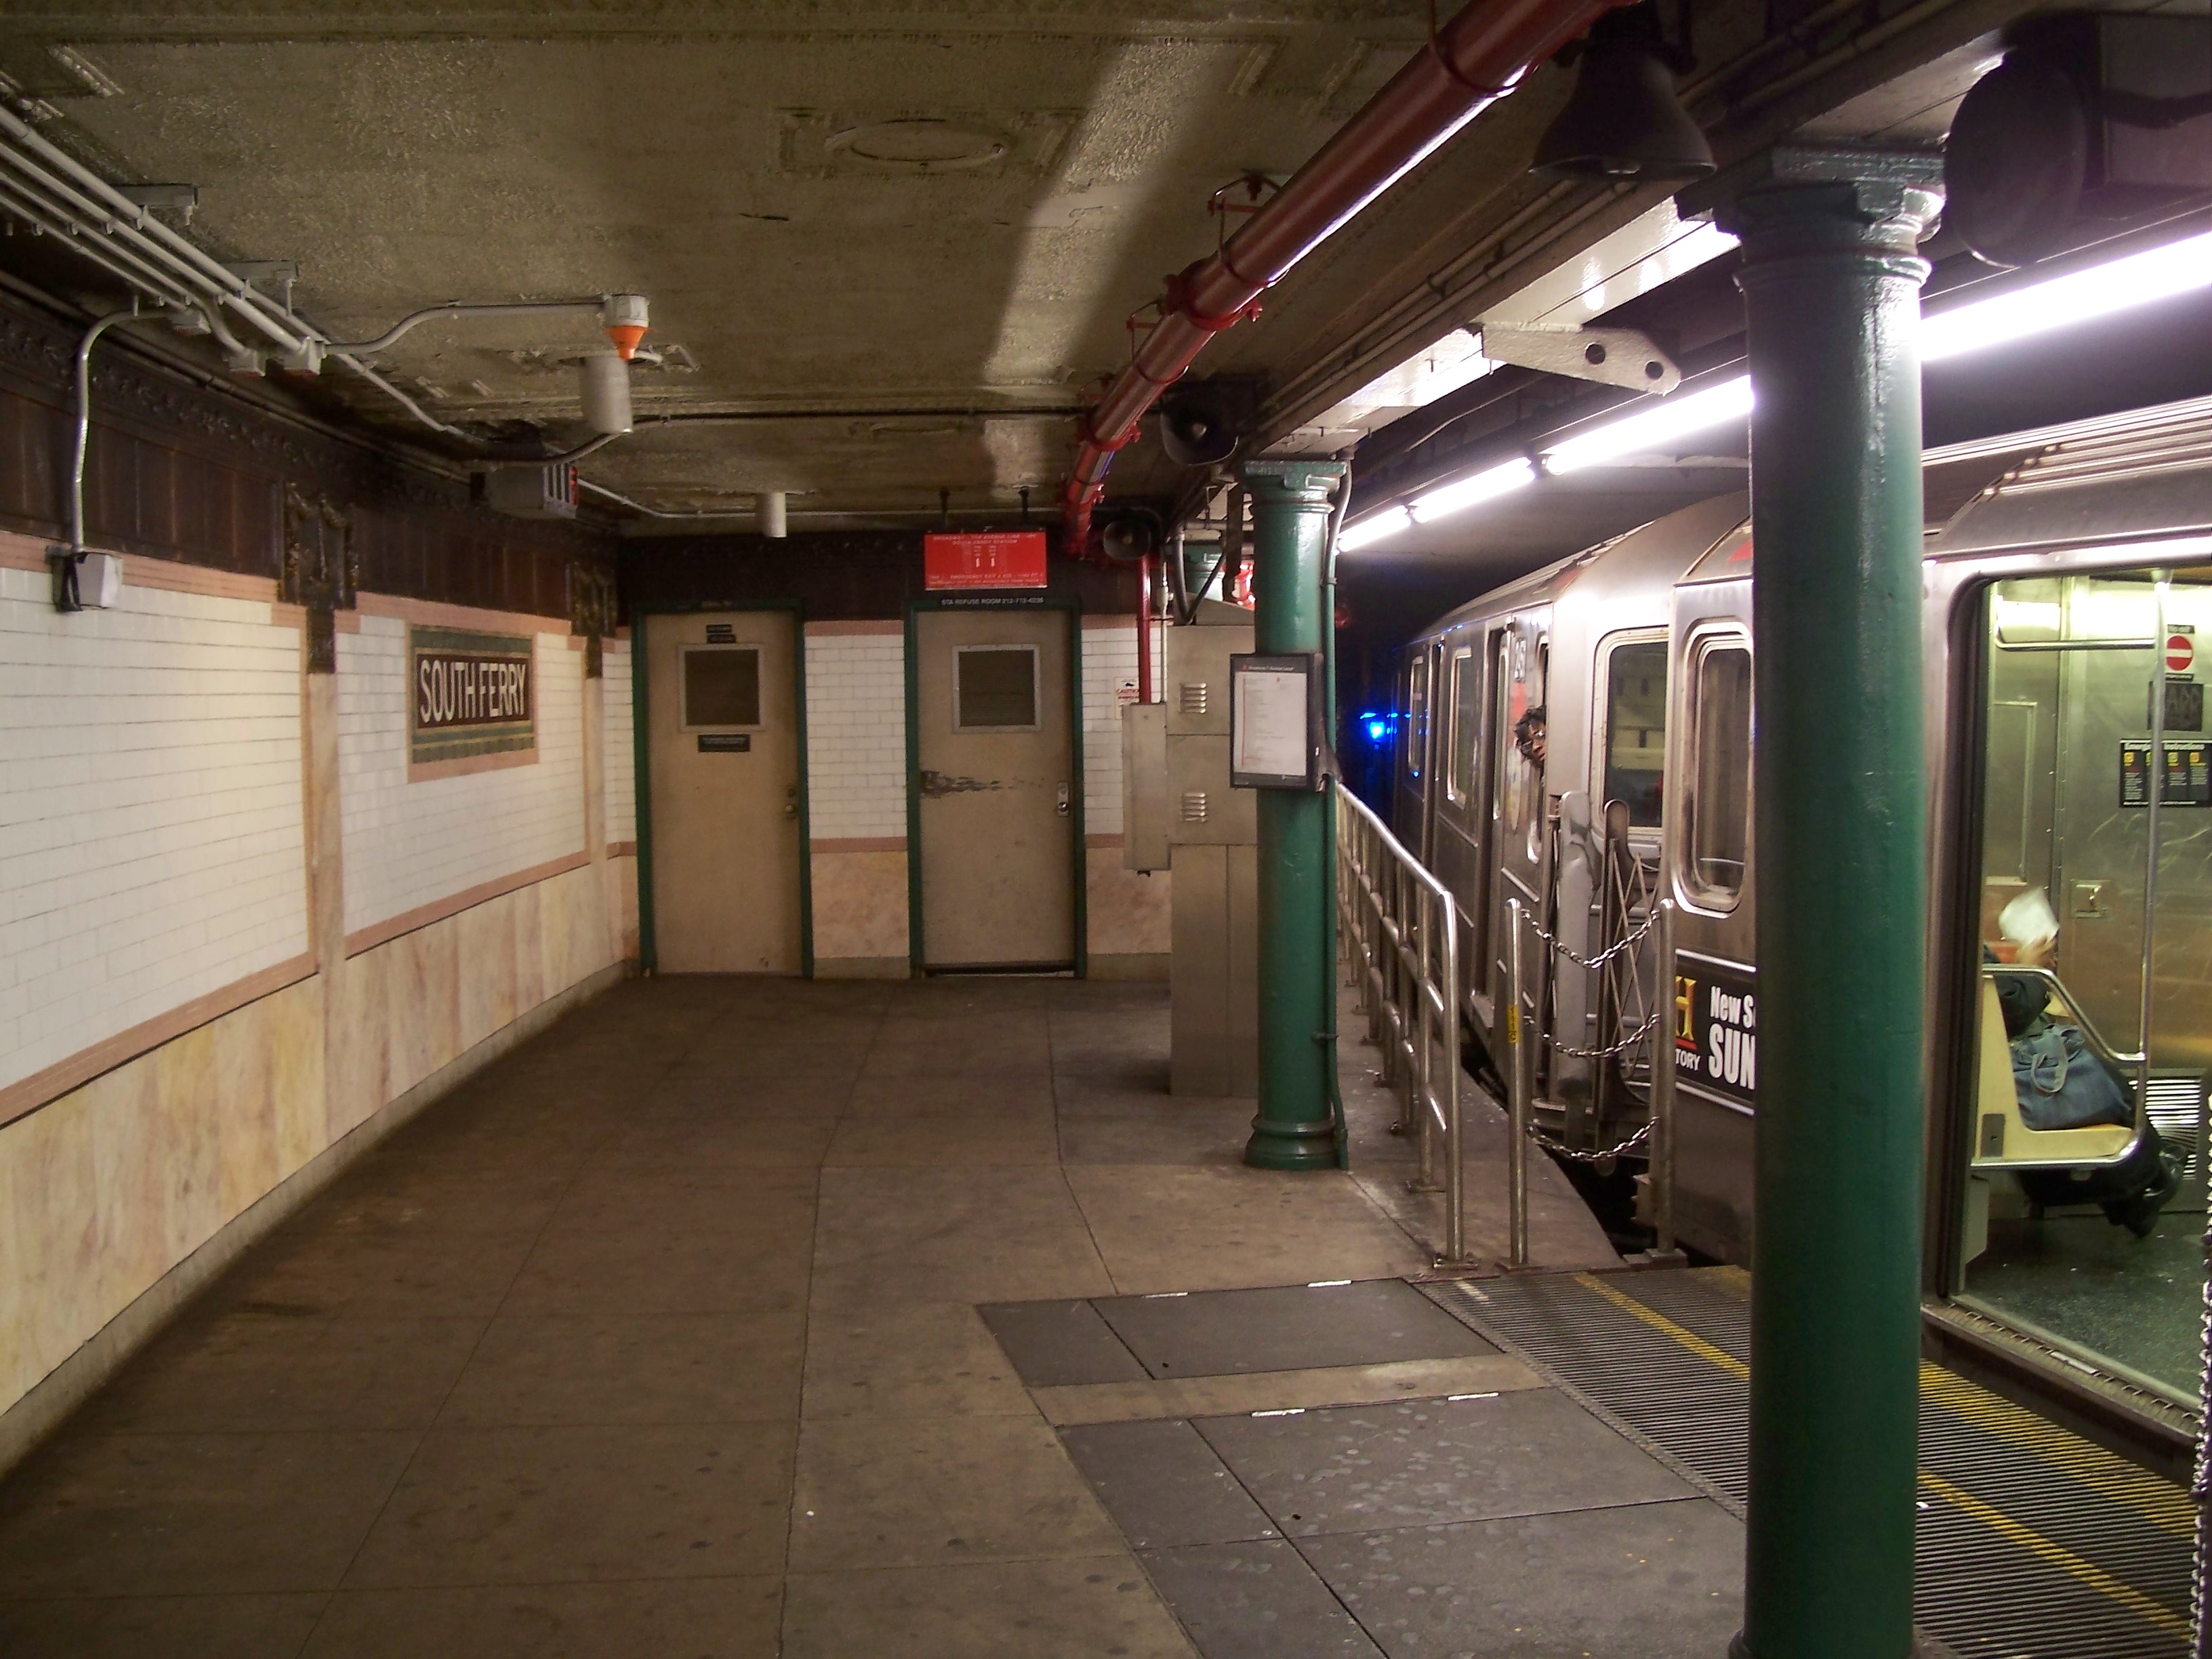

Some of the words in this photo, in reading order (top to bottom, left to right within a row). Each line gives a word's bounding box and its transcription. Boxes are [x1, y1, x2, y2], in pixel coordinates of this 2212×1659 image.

[420, 659, 476, 724] SOUTH
[479, 661, 527, 718] FERRY
[1710, 985, 1742, 1025] New
[1742, 994, 1757, 1029] S
[1675, 1048, 1702, 1071] TORY
